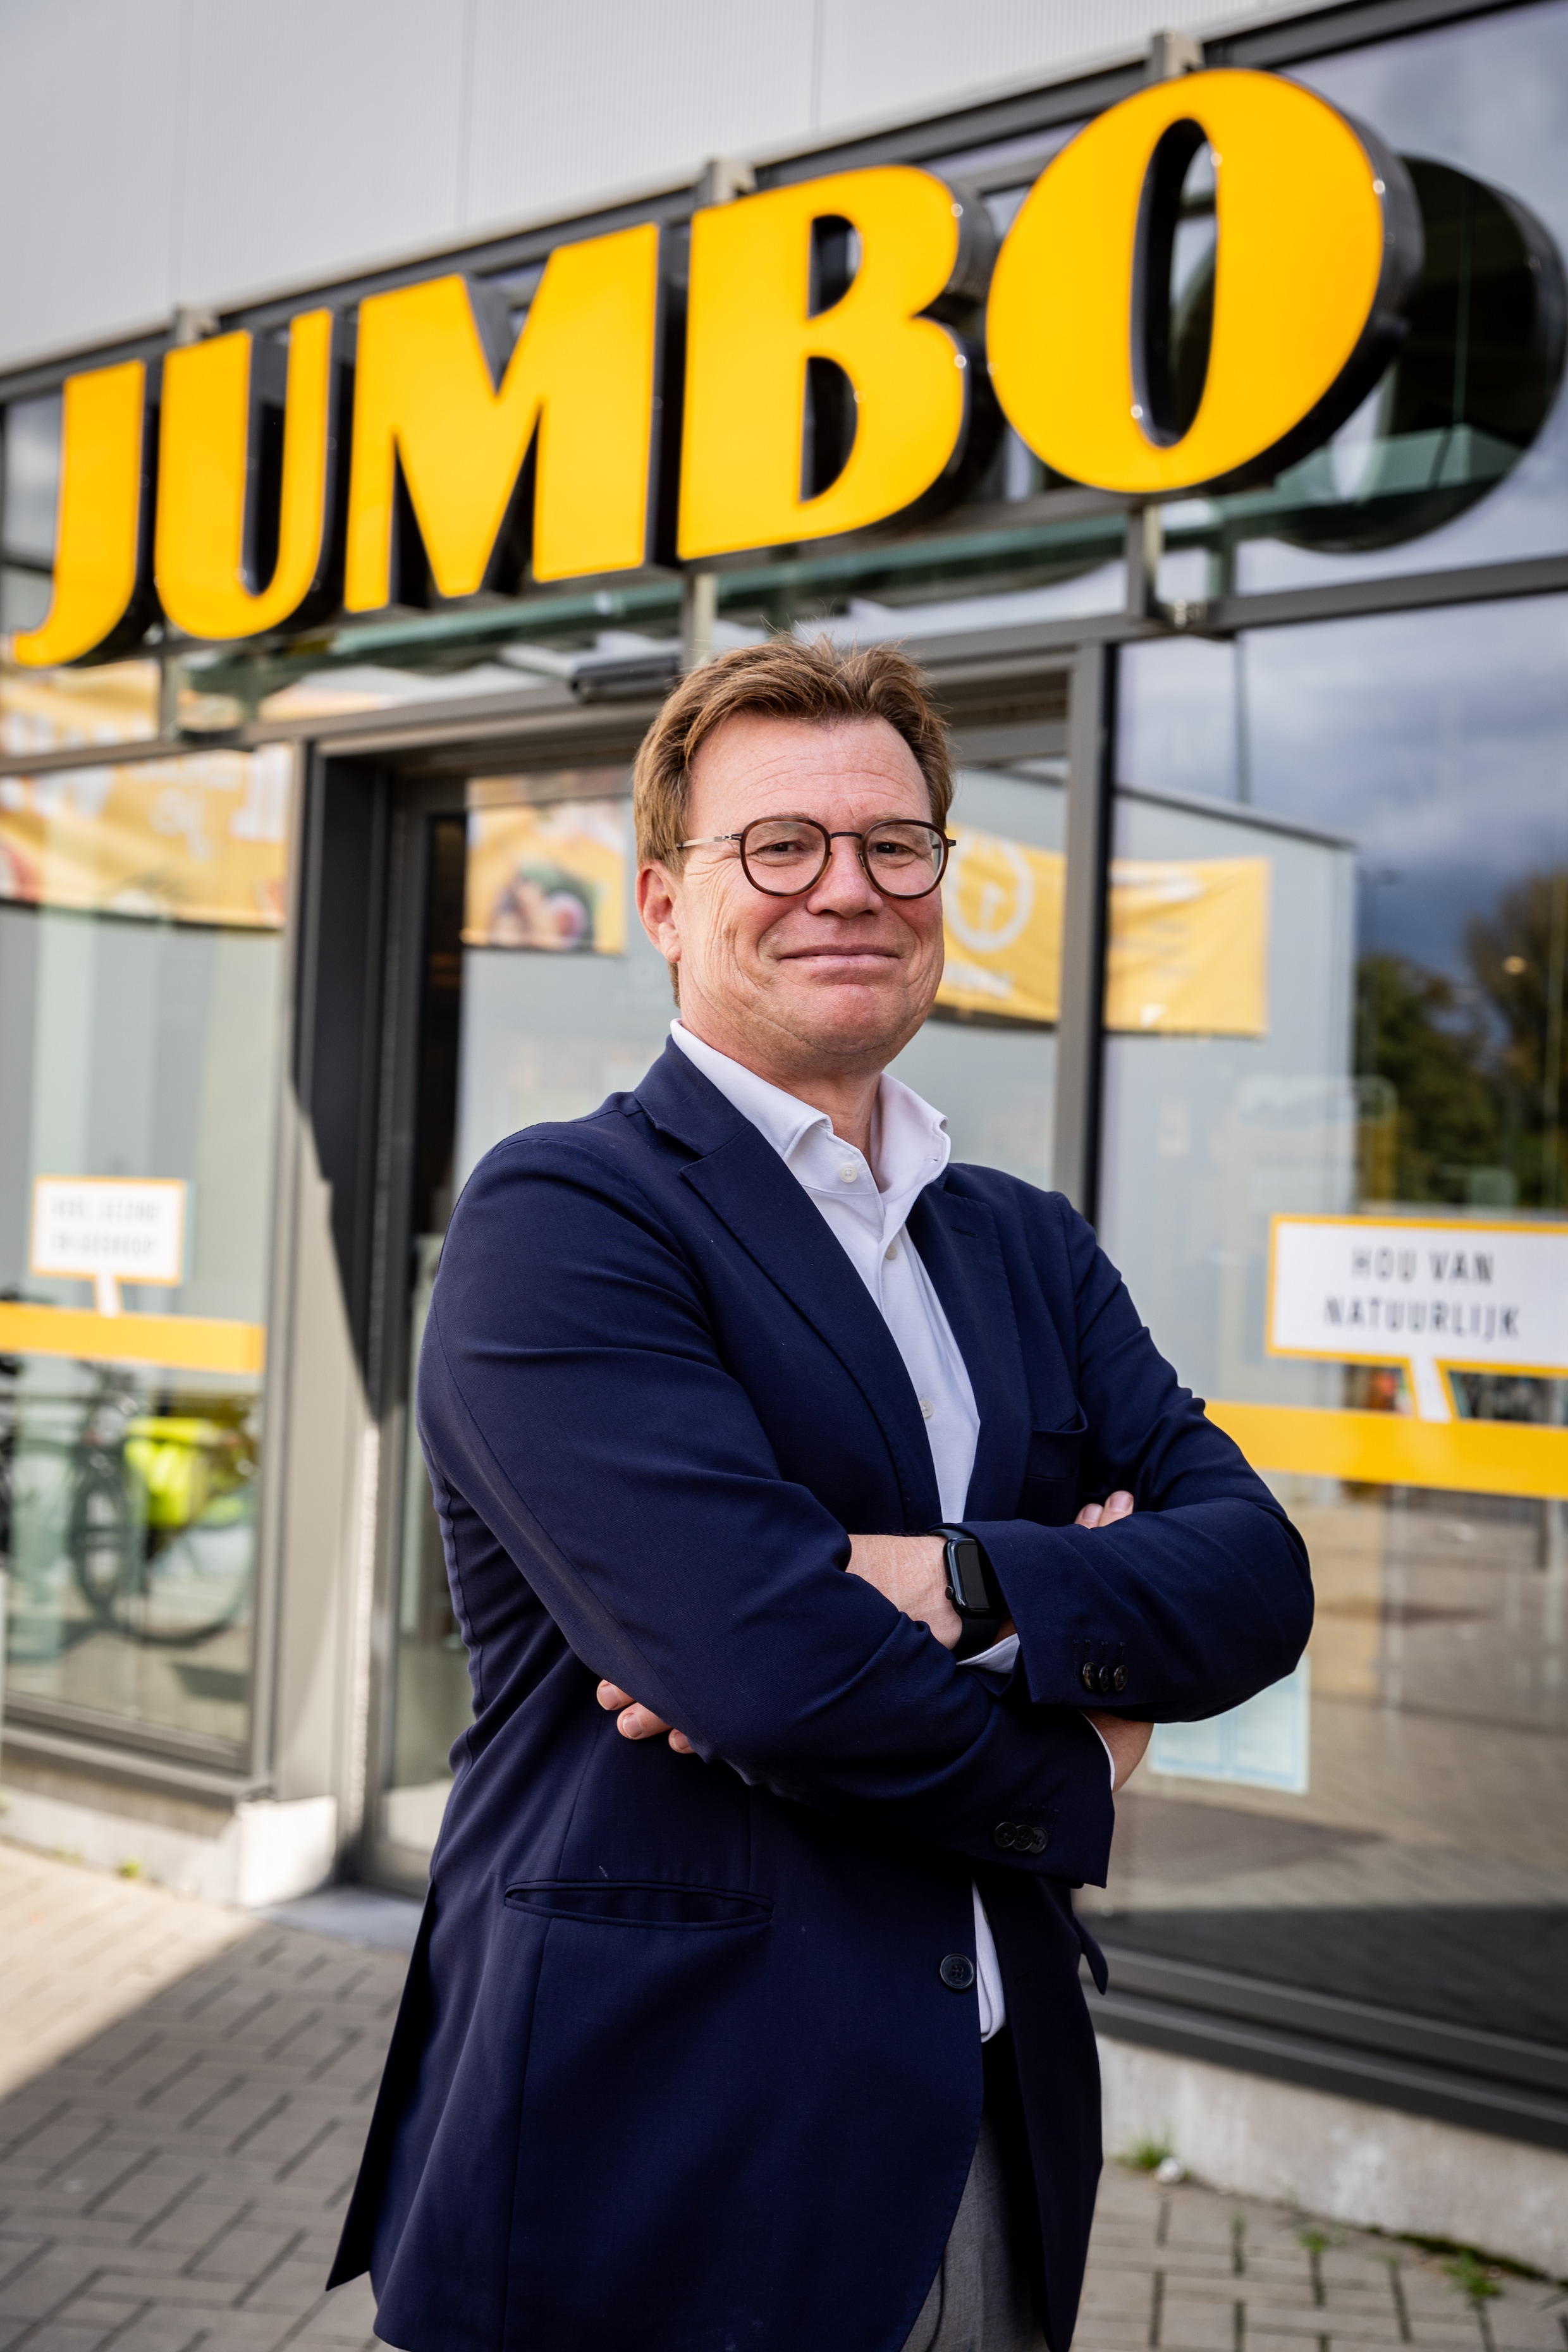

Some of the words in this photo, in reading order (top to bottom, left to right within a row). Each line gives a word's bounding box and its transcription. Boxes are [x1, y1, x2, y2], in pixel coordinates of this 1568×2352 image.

[11, 70, 1383, 669] JUMBO
[1351, 1246, 1417, 1282] HOU
[1428, 1250, 1494, 1285] VAN
[1325, 1295, 1519, 1343] NATUURLIJK
